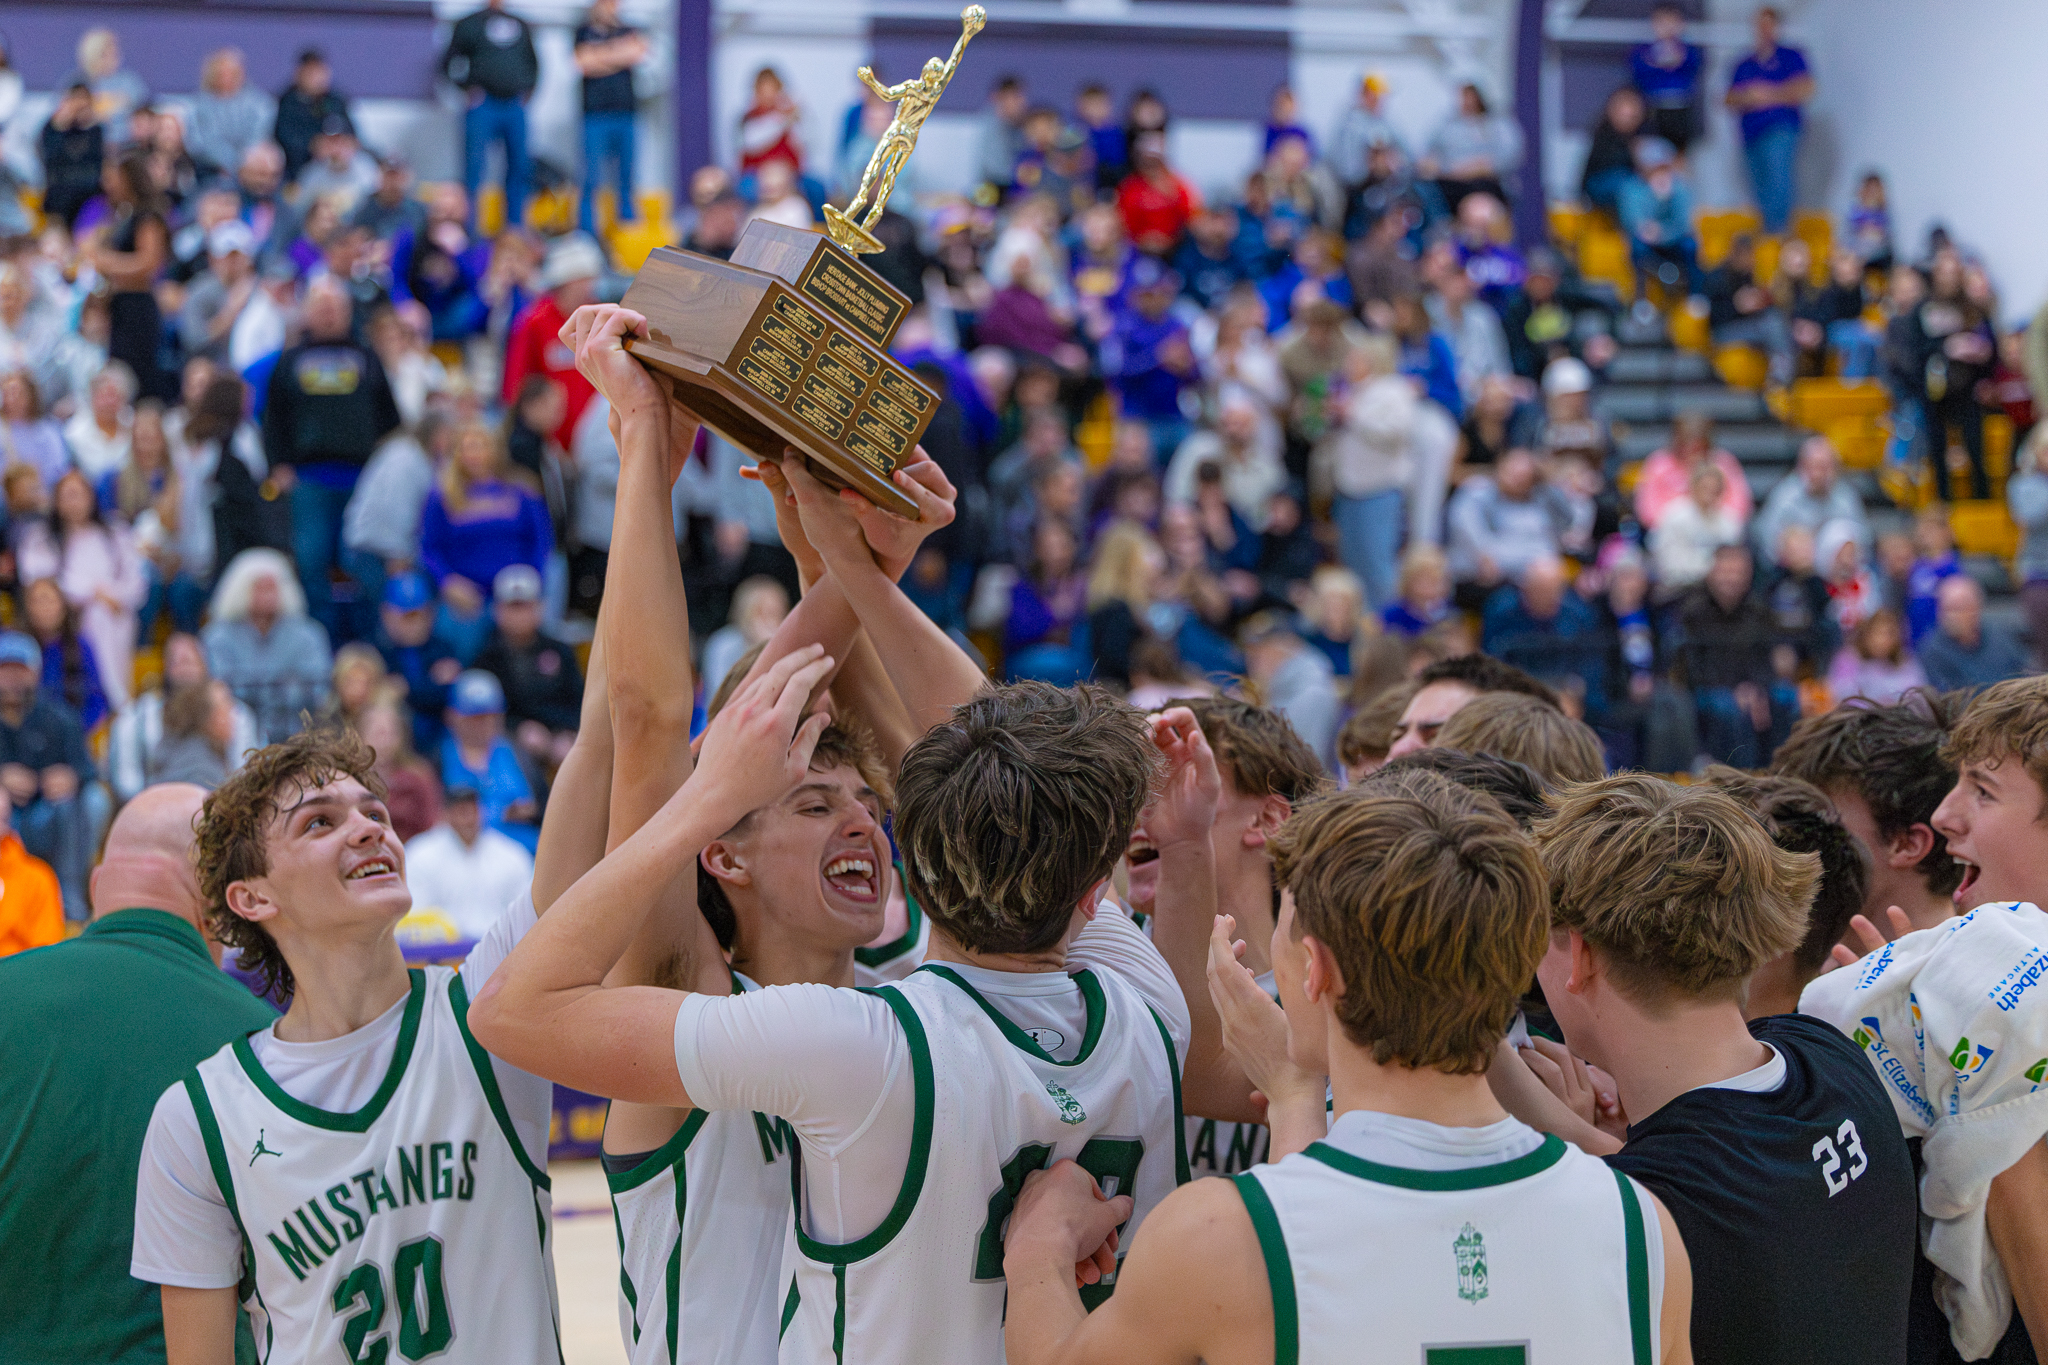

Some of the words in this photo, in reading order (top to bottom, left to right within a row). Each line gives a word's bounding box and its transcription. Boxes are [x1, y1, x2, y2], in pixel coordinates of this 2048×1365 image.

[810, 276, 827, 292] BISHOP
[824, 286, 847, 307] BROSSART
[848, 304, 870, 324] CAMPBELL
[867, 318, 885, 336] COUNTY
[820, 271, 847, 295] CROSSTOWN
[844, 289, 870, 312] BASKETBALL
[866, 306, 885, 323] CLASSIC
[826, 263, 847, 283] HERITAGE
[844, 277, 858, 291] BANK
[856, 286, 871, 301] JOLLY
[867, 294, 889, 314] PLUMBING
[1882, 1058, 1935, 1118] Elizabeth
[1811, 1118, 1868, 1198] 23
[265, 1140, 479, 1283] MUSTANGS
[330, 1231, 457, 1365] 20
